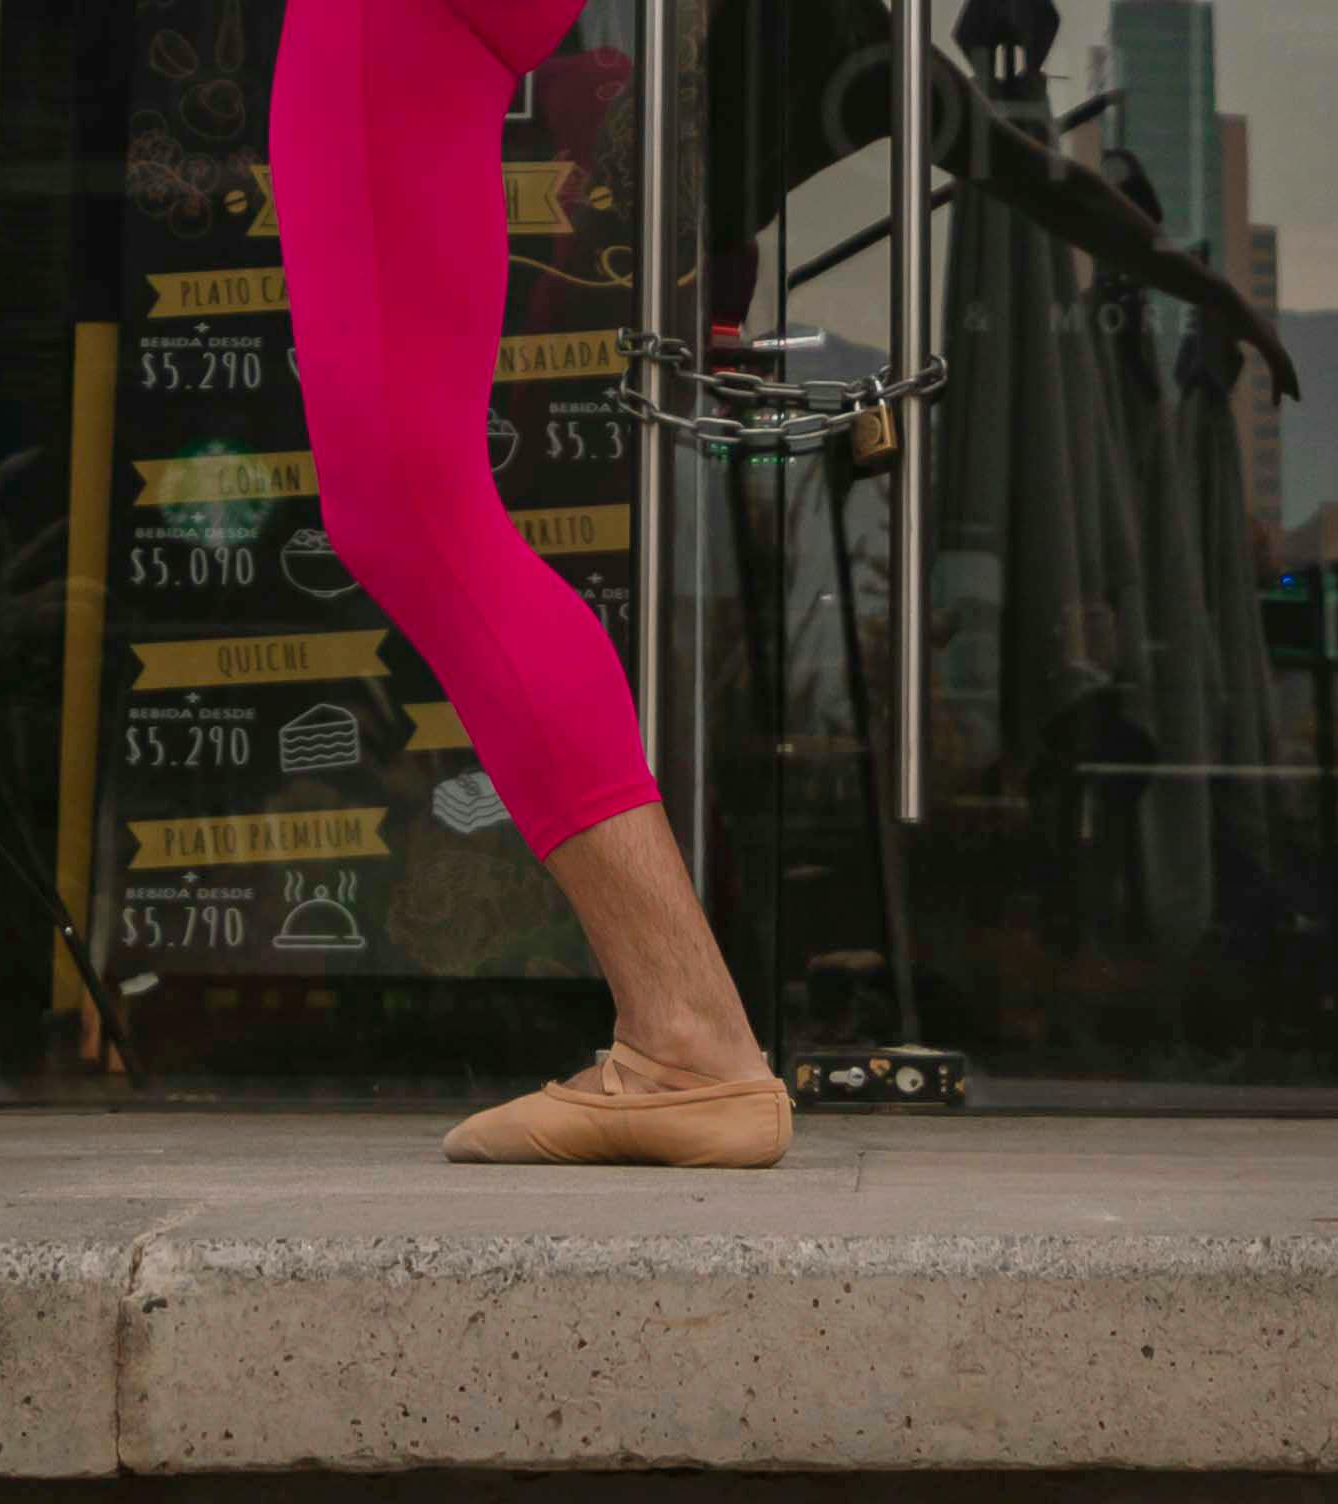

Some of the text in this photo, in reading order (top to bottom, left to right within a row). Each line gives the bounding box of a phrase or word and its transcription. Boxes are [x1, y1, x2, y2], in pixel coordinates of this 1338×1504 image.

[180, 277, 250, 308] PLATO
[140, 336, 263, 348] BEBIDA DESDE
[498, 339, 610, 373] NSALADA
[140, 351, 262, 390] $5.290
[548, 401, 611, 413] BEBIDA
[133, 527, 199, 539] BEBIDA
[128, 545, 255, 587] $5.090
[217, 641, 310, 678] QUICHE
[127, 707, 257, 721] BEBIDA DESDE
[124, 724, 250, 767] $5.290
[163, 816, 364, 858] PLATO PREMIUM
[124, 886, 255, 901] BEBIDA DESDE
[121, 904, 245, 948] $5.790
